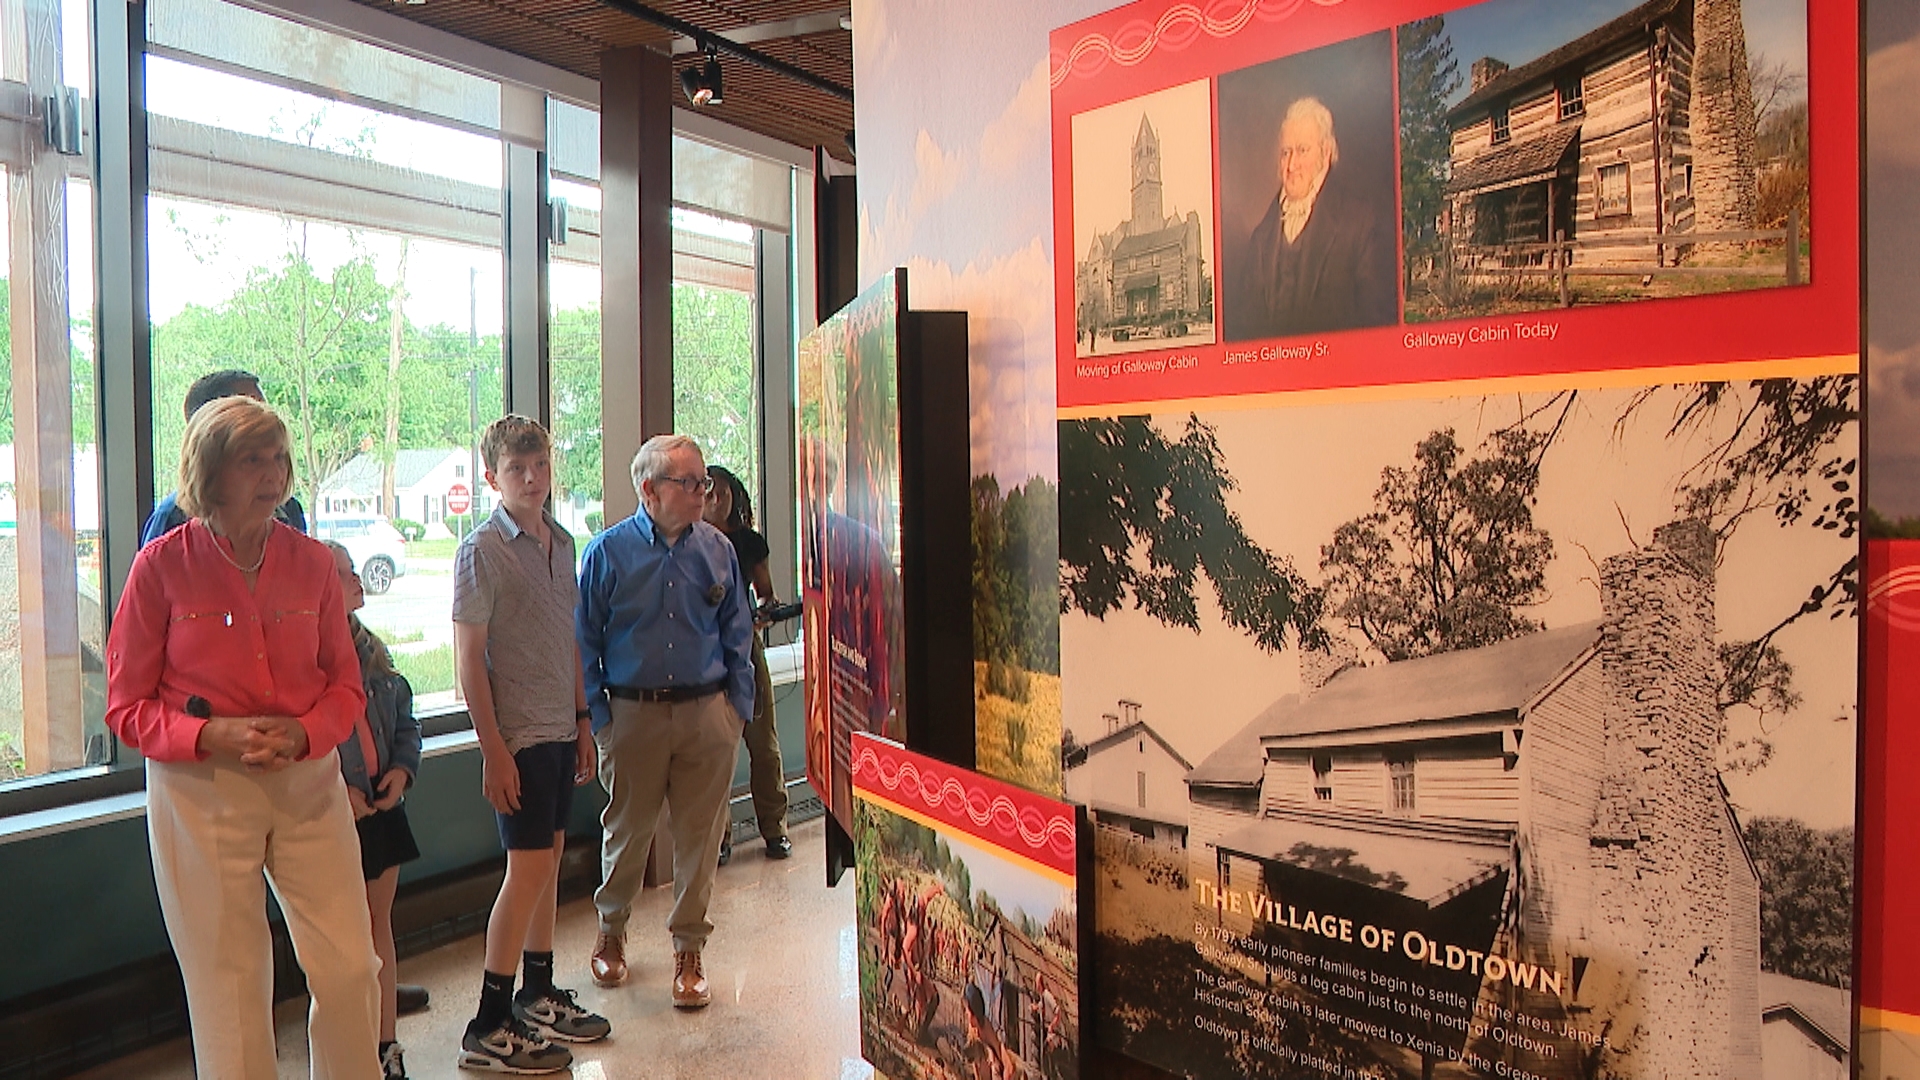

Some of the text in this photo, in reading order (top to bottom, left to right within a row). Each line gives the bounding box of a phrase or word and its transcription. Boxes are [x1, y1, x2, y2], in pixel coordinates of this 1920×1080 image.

[1076, 355, 1199, 379] Moving of Galloway Cabin
[1222, 342, 1330, 365] James Galloway Sr.
[1403, 322, 1559, 349] Galloway Cabin Today
[1195, 878, 1562, 996] THE VILLAGE OF OLDTOWN
[1194, 987, 1288, 1030] Historical Society.
[1195, 922, 1612, 1049] By 1797, early pioneer families begin to settle in the area. James
[1247, 957, 1262, 973] Sr.
[1264, 961, 1297, 982] builds
[1300, 974, 1308, 985] a
[1310, 974, 1329, 994] log
[1332, 982, 1366, 1002] cabin
[1368, 993, 1391, 1010] just
[1393, 999, 1407, 1015] to
[1410, 1002, 1432, 1023] the
[1436, 1011, 1471, 1034] north
[1475, 1023, 1490, 1038] of
[1492, 1027, 1559, 1058] Oldtown.
[1195, 969, 1215, 985] The
[1217, 974, 1267, 1006] Galloway
[1269, 993, 1300, 1013] cabin
[1302, 1002, 1312, 1017] is
[1315, 1005, 1342, 1025] later
[1345, 1016, 1387, 1040] moved
[1390, 1028, 1404, 1044] to
[1406, 1033, 1444, 1058] Xenia
[1448, 1046, 1465, 1066] by
[1469, 1053, 1492, 1073] the
[1195, 1015, 1239, 1042] Oldtown
[1242, 1029, 1250, 1046] is
[1252, 1036, 1298, 1064] officially
[1300, 1052, 1341, 1077] platted
[1344, 1064, 1356, 1080] in
